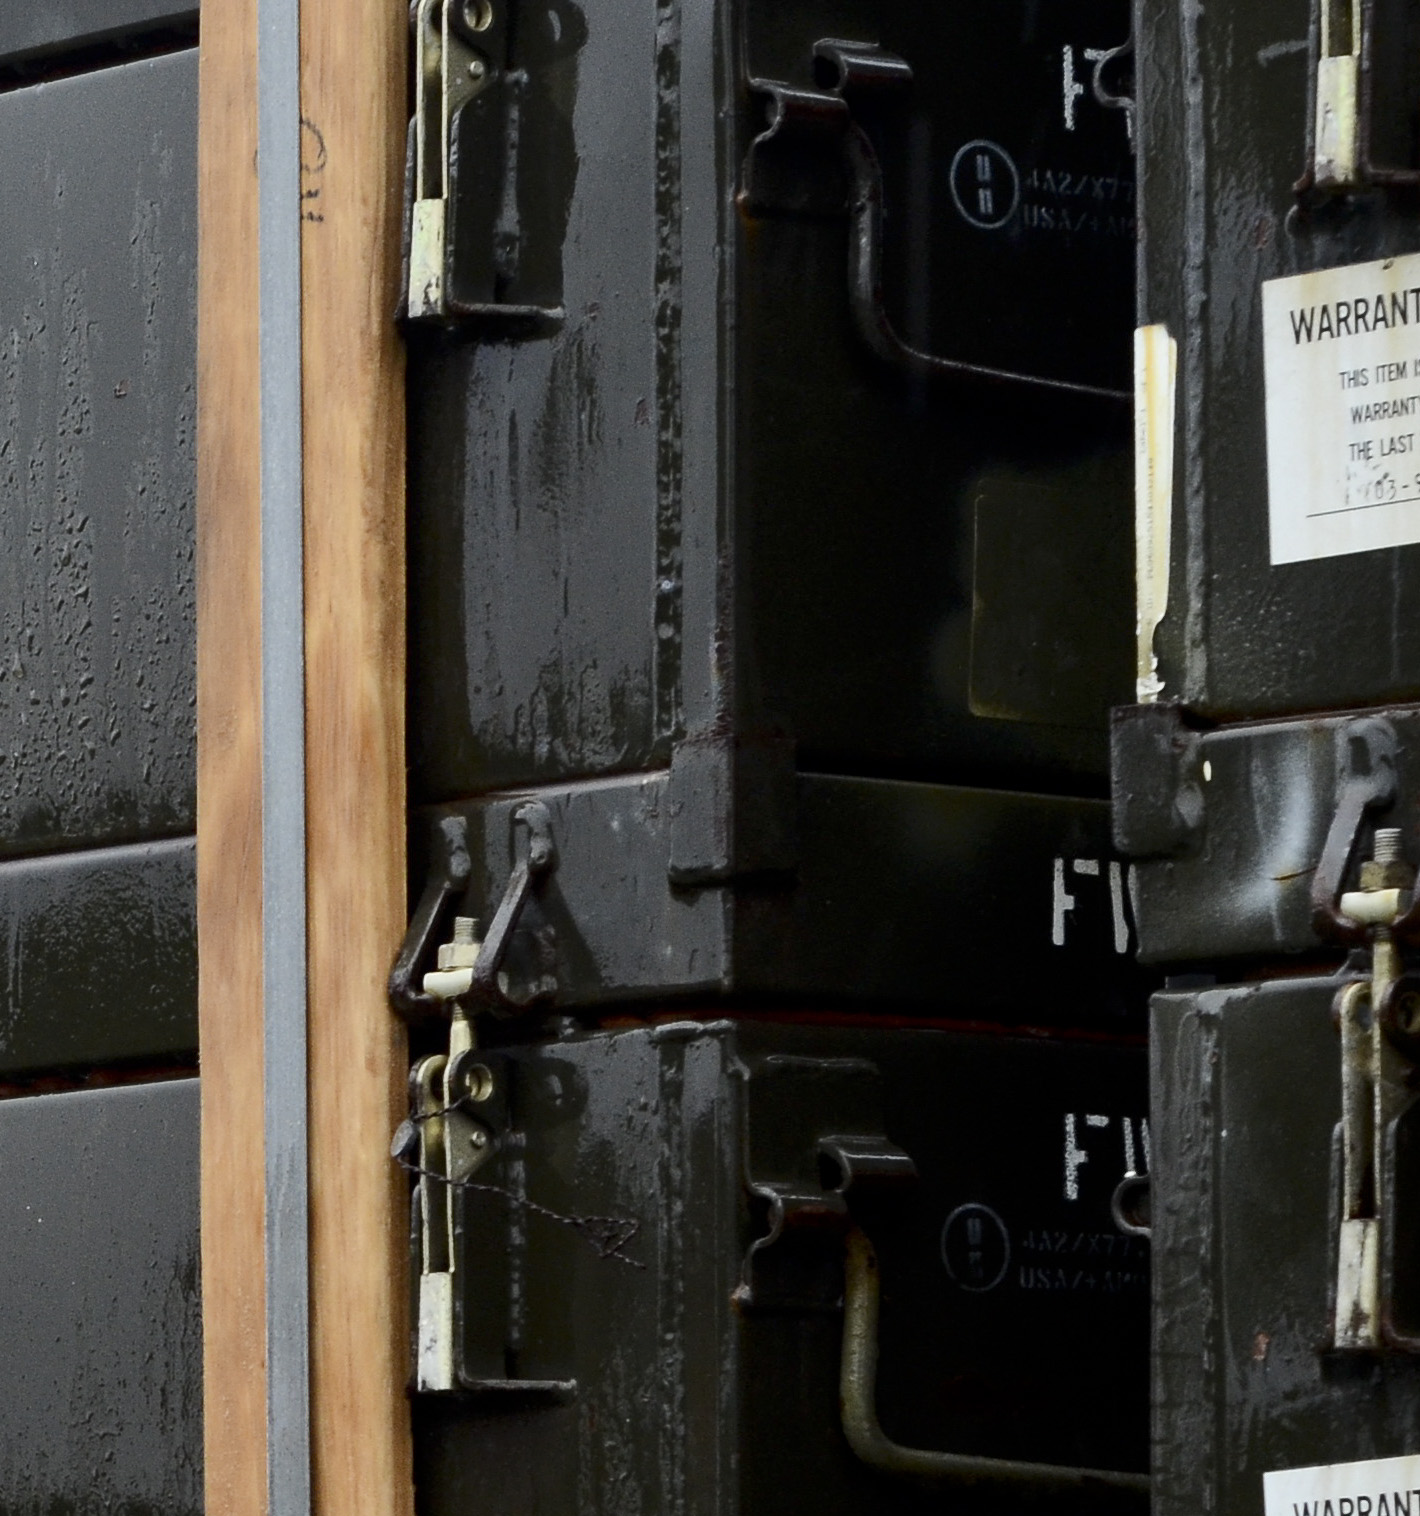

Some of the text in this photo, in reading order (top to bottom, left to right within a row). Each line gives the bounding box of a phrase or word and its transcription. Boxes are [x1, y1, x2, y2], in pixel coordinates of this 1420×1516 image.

[1339, 361, 1408, 390] THIS ITEM
[1349, 433, 1414, 462] THE LAST
